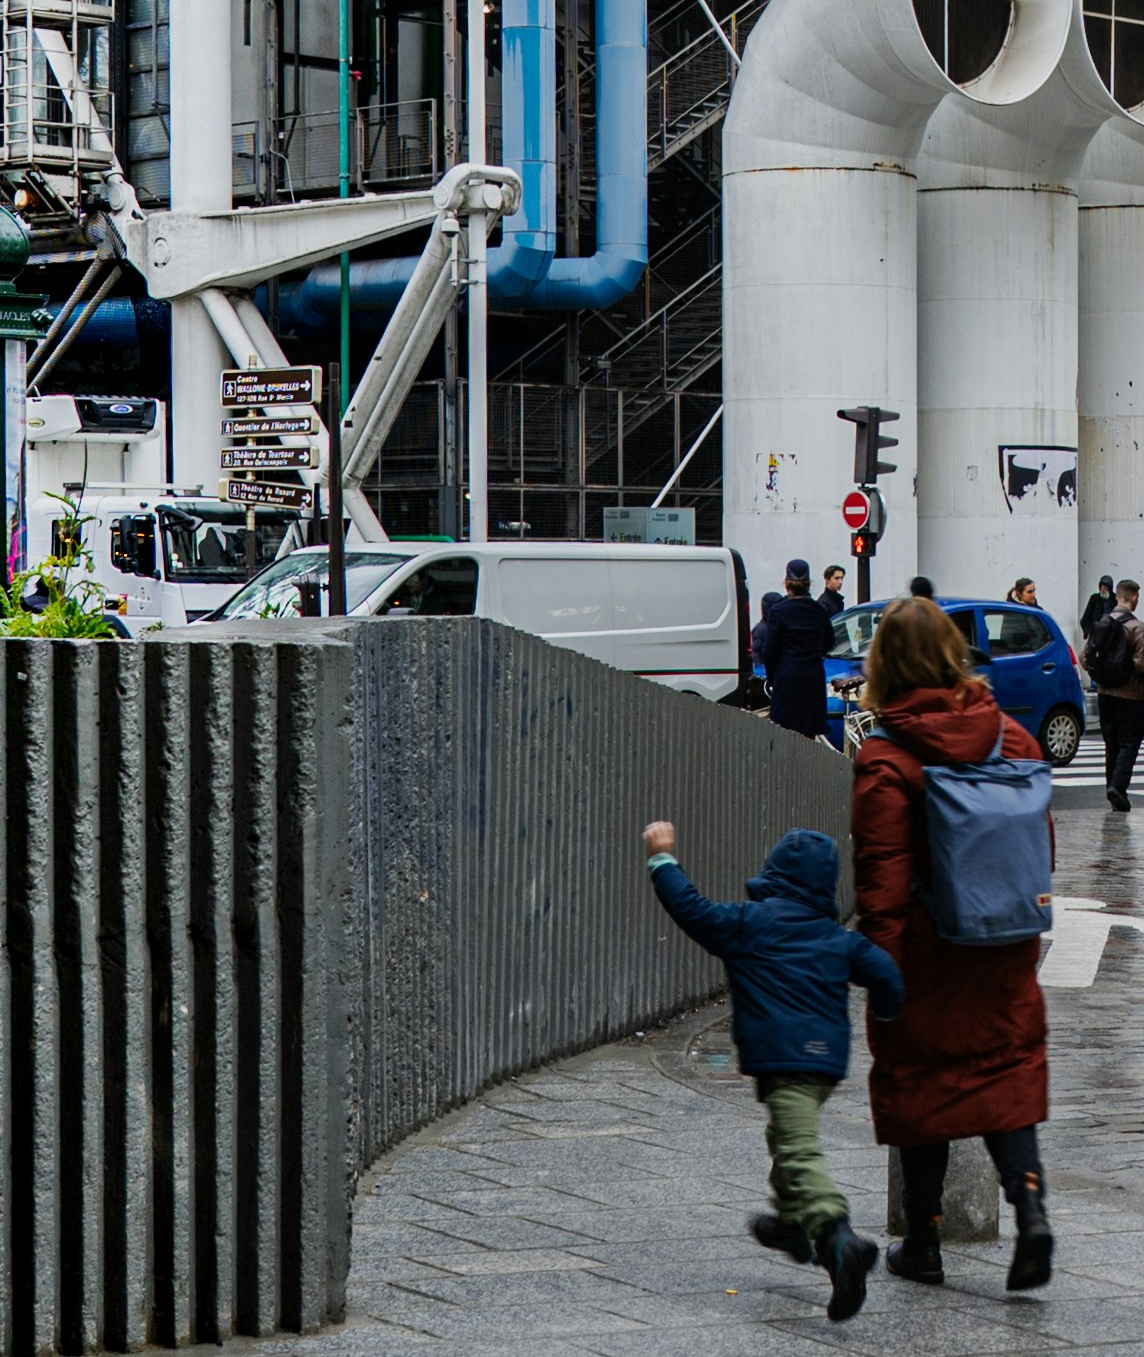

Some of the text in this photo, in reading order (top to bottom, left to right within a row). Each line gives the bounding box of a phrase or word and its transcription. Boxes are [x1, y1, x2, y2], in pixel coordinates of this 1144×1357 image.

[237, 375, 258, 383] Centre
[233, 422, 260, 432] Quartier
[261, 422, 270, 430] de
